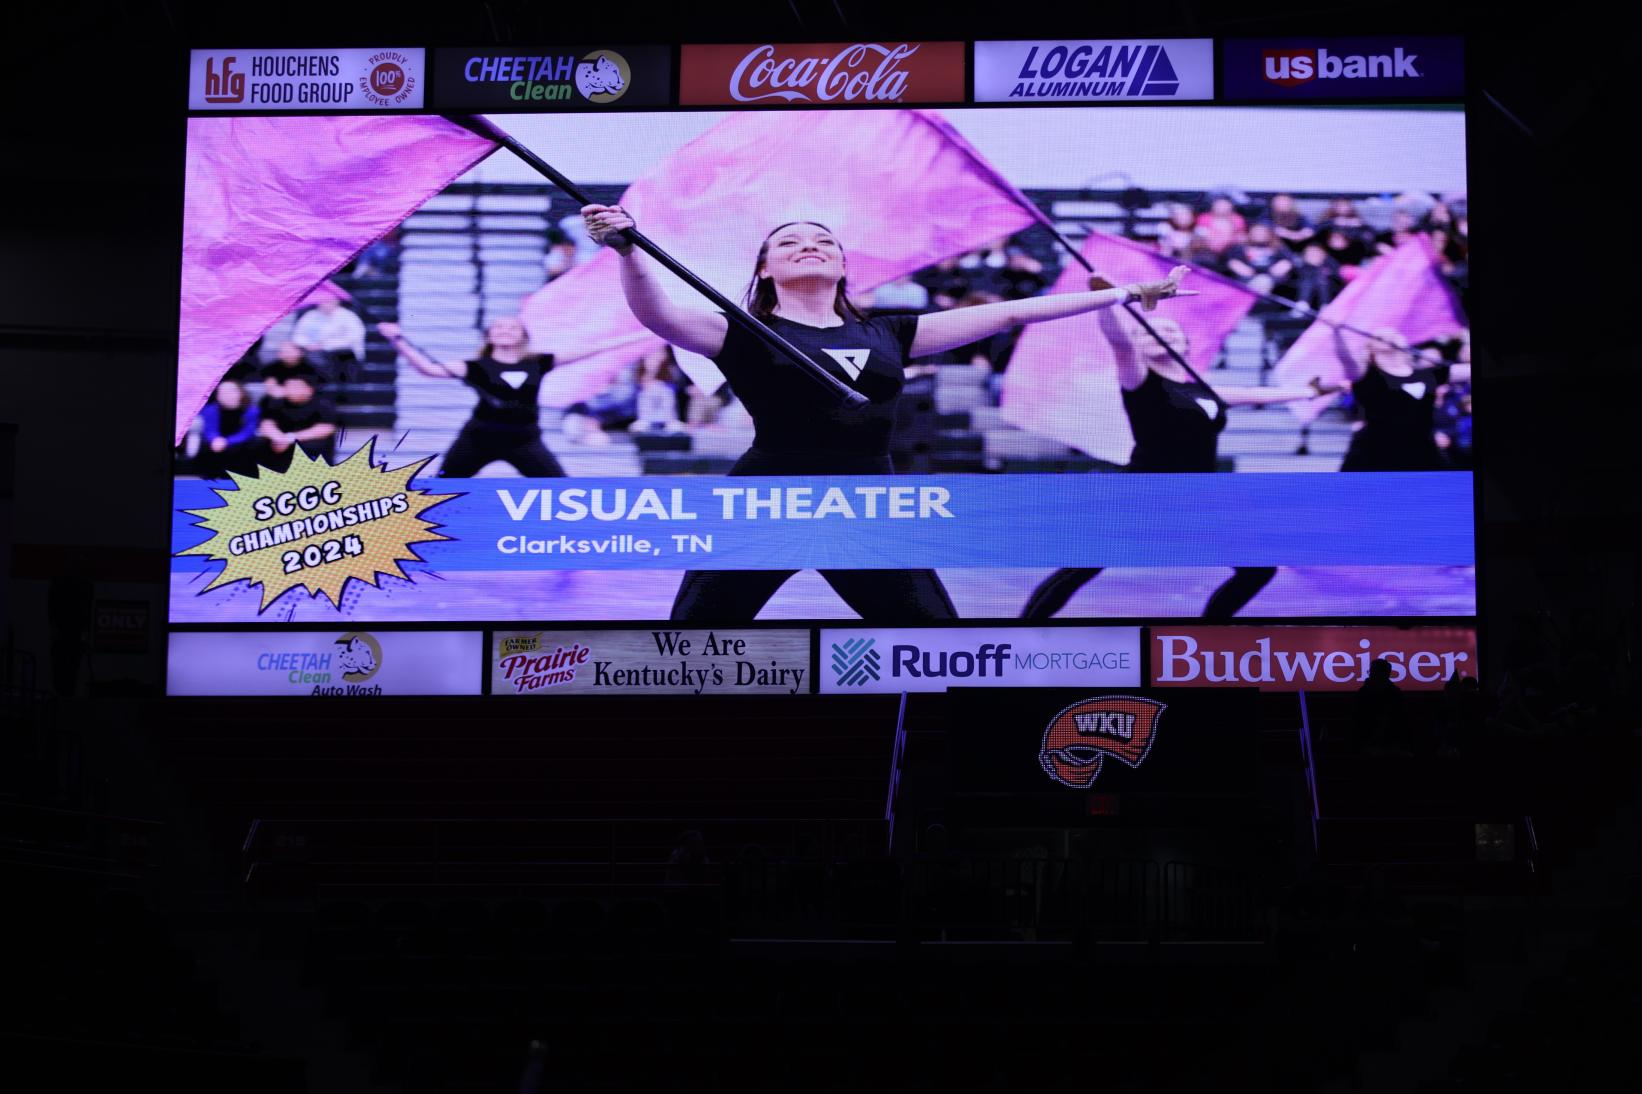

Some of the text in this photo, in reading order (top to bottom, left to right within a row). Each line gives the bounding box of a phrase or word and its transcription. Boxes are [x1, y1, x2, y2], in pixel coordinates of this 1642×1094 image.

[252, 56, 340, 77] HOUCHENS
[368, 51, 408, 65] PROUDLY
[464, 56, 574, 82] CHEETAH
[1018, 45, 1142, 79] LOGAN
[205, 56, 246, 104] hfg
[729, 44, 920, 102] Coca-Cola
[251, 82, 354, 104] FOOD GROUP
[359, 77, 415, 106] EMPLOYEE OWNED
[510, 81, 572, 100] Clean
[1008, 81, 1126, 97] ALUMINUM
[253, 481, 342, 520] SCGC
[496, 486, 956, 521] VISUAL THEATER
[228, 493, 409, 556] CHAMPIONSHIPS
[282, 535, 363, 574] 2024
[497, 535, 713, 556] Clarksville, TN
[652, 631, 746, 656] We Are
[257, 653, 332, 670] CHEETAH
[500, 644, 590, 679] Prairie
[892, 643, 1131, 678] Ruoff MORTGAGE
[1156, 635, 1469, 683] Budweiser
[288, 670, 331, 684] Clean
[311, 683, 382, 696] Auto Wash
[514, 668, 576, 692] Farms
[593, 661, 805, 695] Kentucky's Dairy
[1074, 713, 1136, 739] WKU
